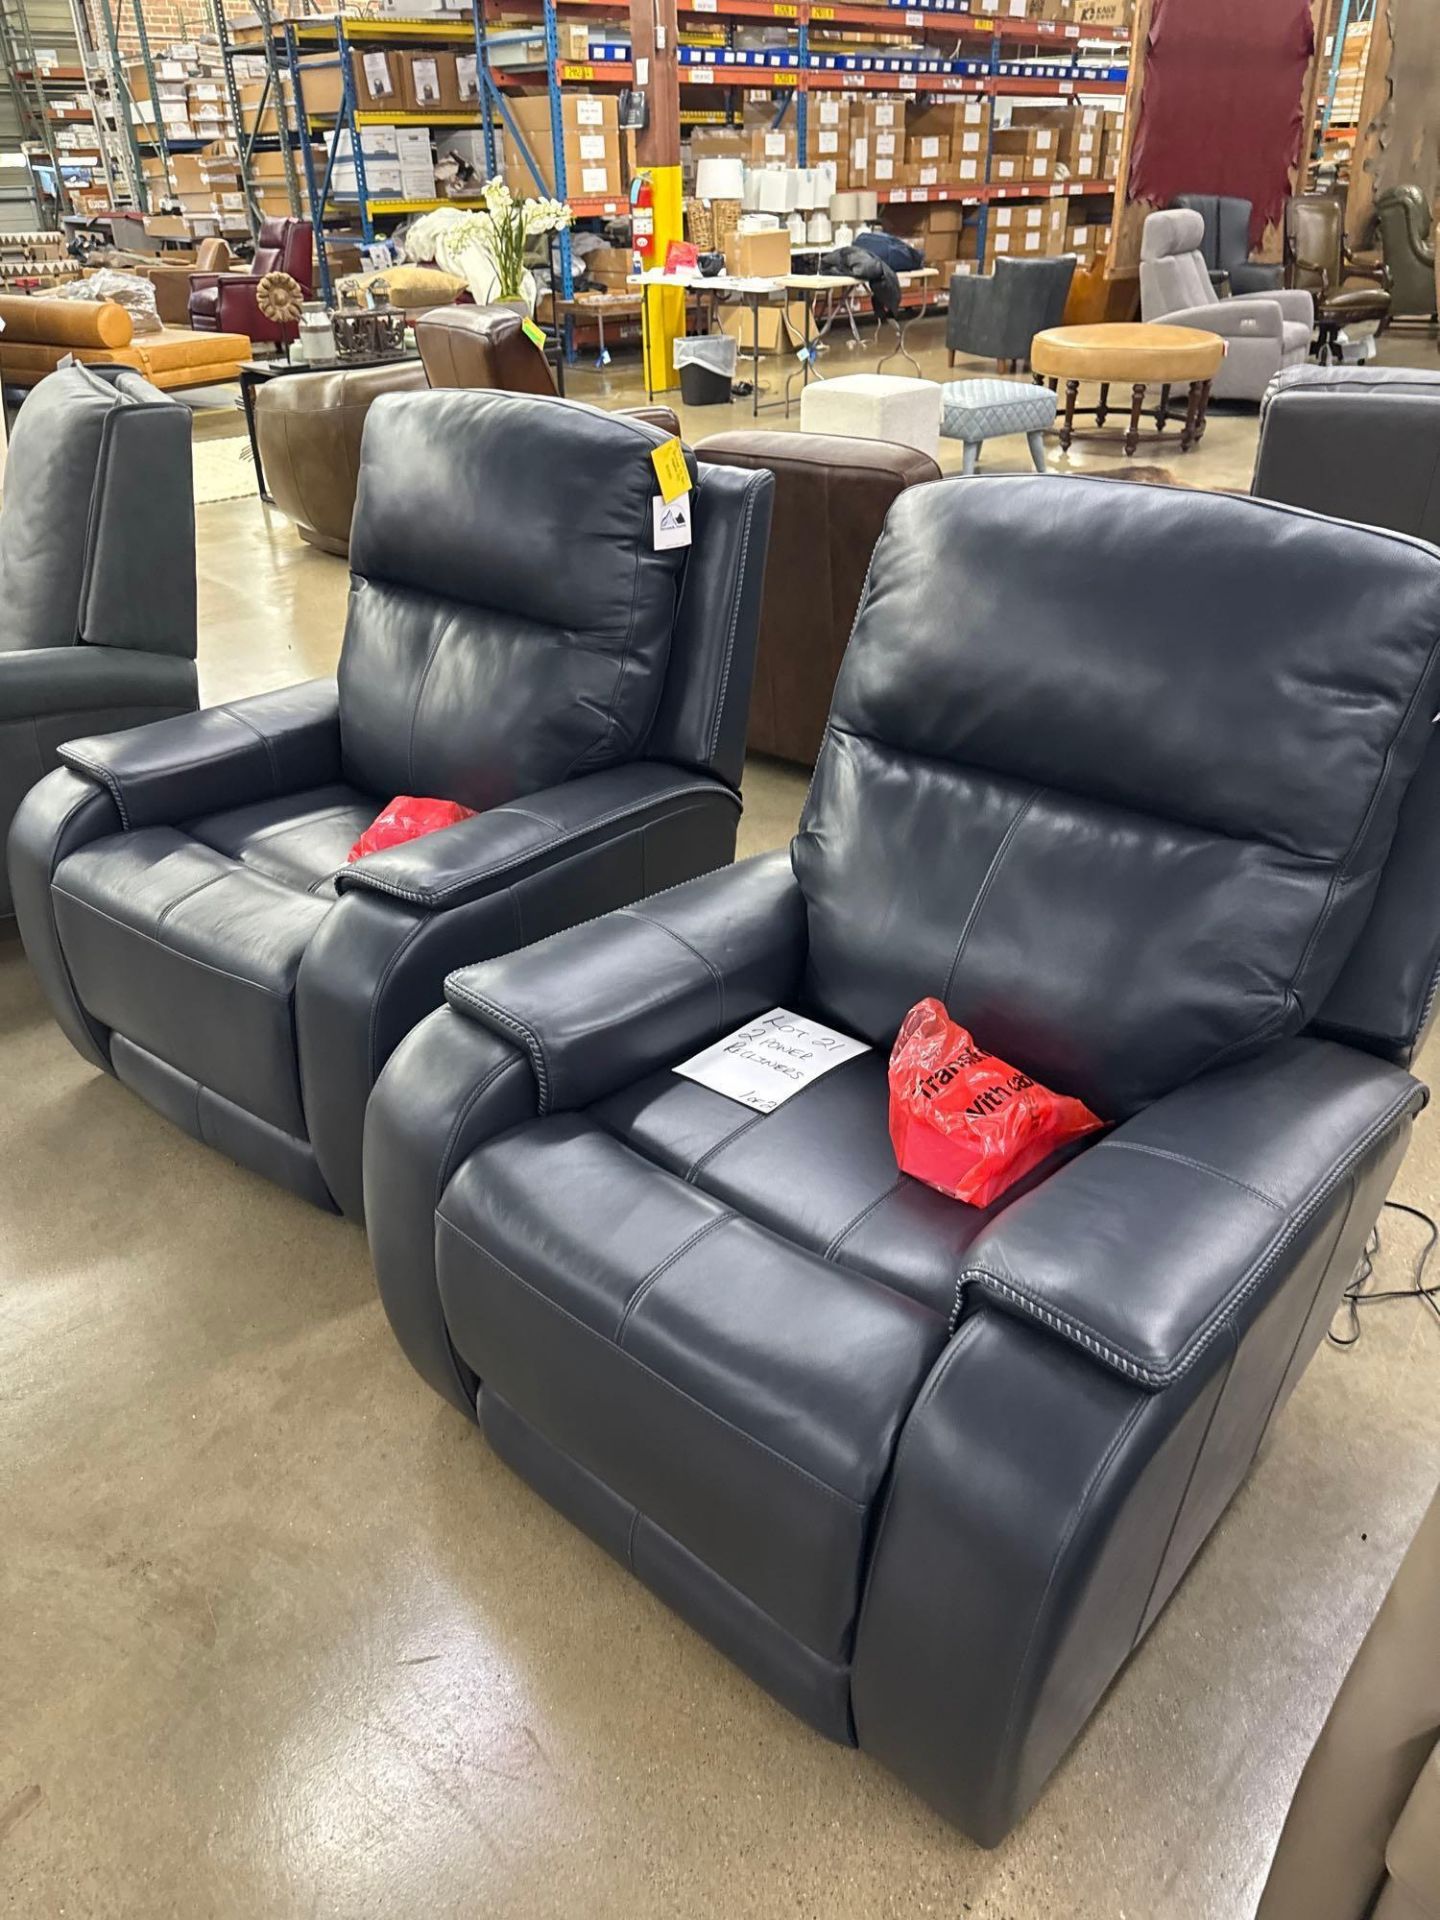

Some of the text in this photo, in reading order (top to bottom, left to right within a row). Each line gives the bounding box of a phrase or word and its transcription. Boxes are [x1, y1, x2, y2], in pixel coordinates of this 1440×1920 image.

[738, 1028, 814, 1061] 2 POWER
[762, 1015, 846, 1052] LOT 21
[759, 1100, 777, 1109] 2
